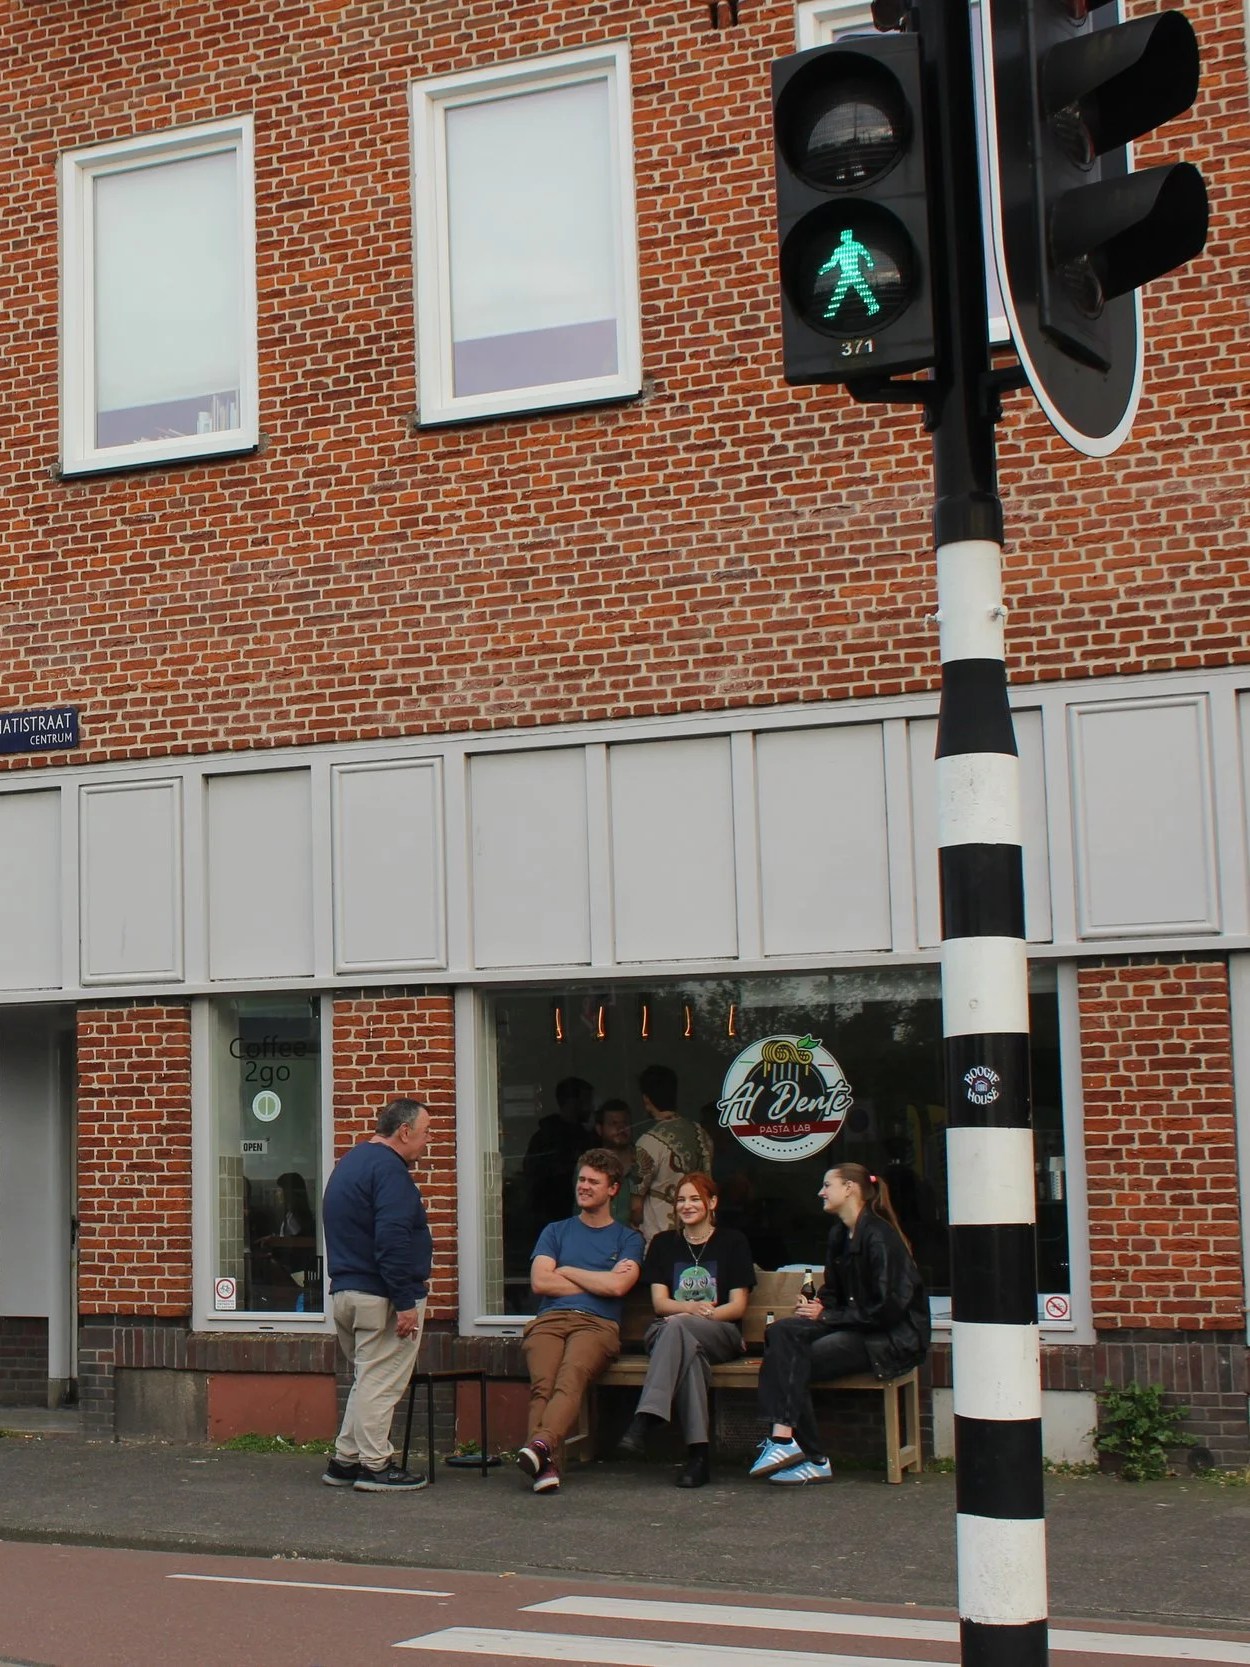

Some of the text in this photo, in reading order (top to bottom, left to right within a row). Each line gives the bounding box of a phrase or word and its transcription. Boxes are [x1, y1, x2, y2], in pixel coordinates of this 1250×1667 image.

[841, 339, 873, 356] 371
[30, 732, 72, 745] CENTRUM
[229, 1035, 307, 1058] Coffee
[245, 1061, 290, 1088] 2go
[963, 1066, 1000, 1085] BOOGIE
[718, 1079, 852, 1126] Al Dente
[967, 1086, 1000, 1105] HOUSE
[759, 1124, 811, 1134] PASTA LAB
[243, 1142, 263, 1152] OPEN
